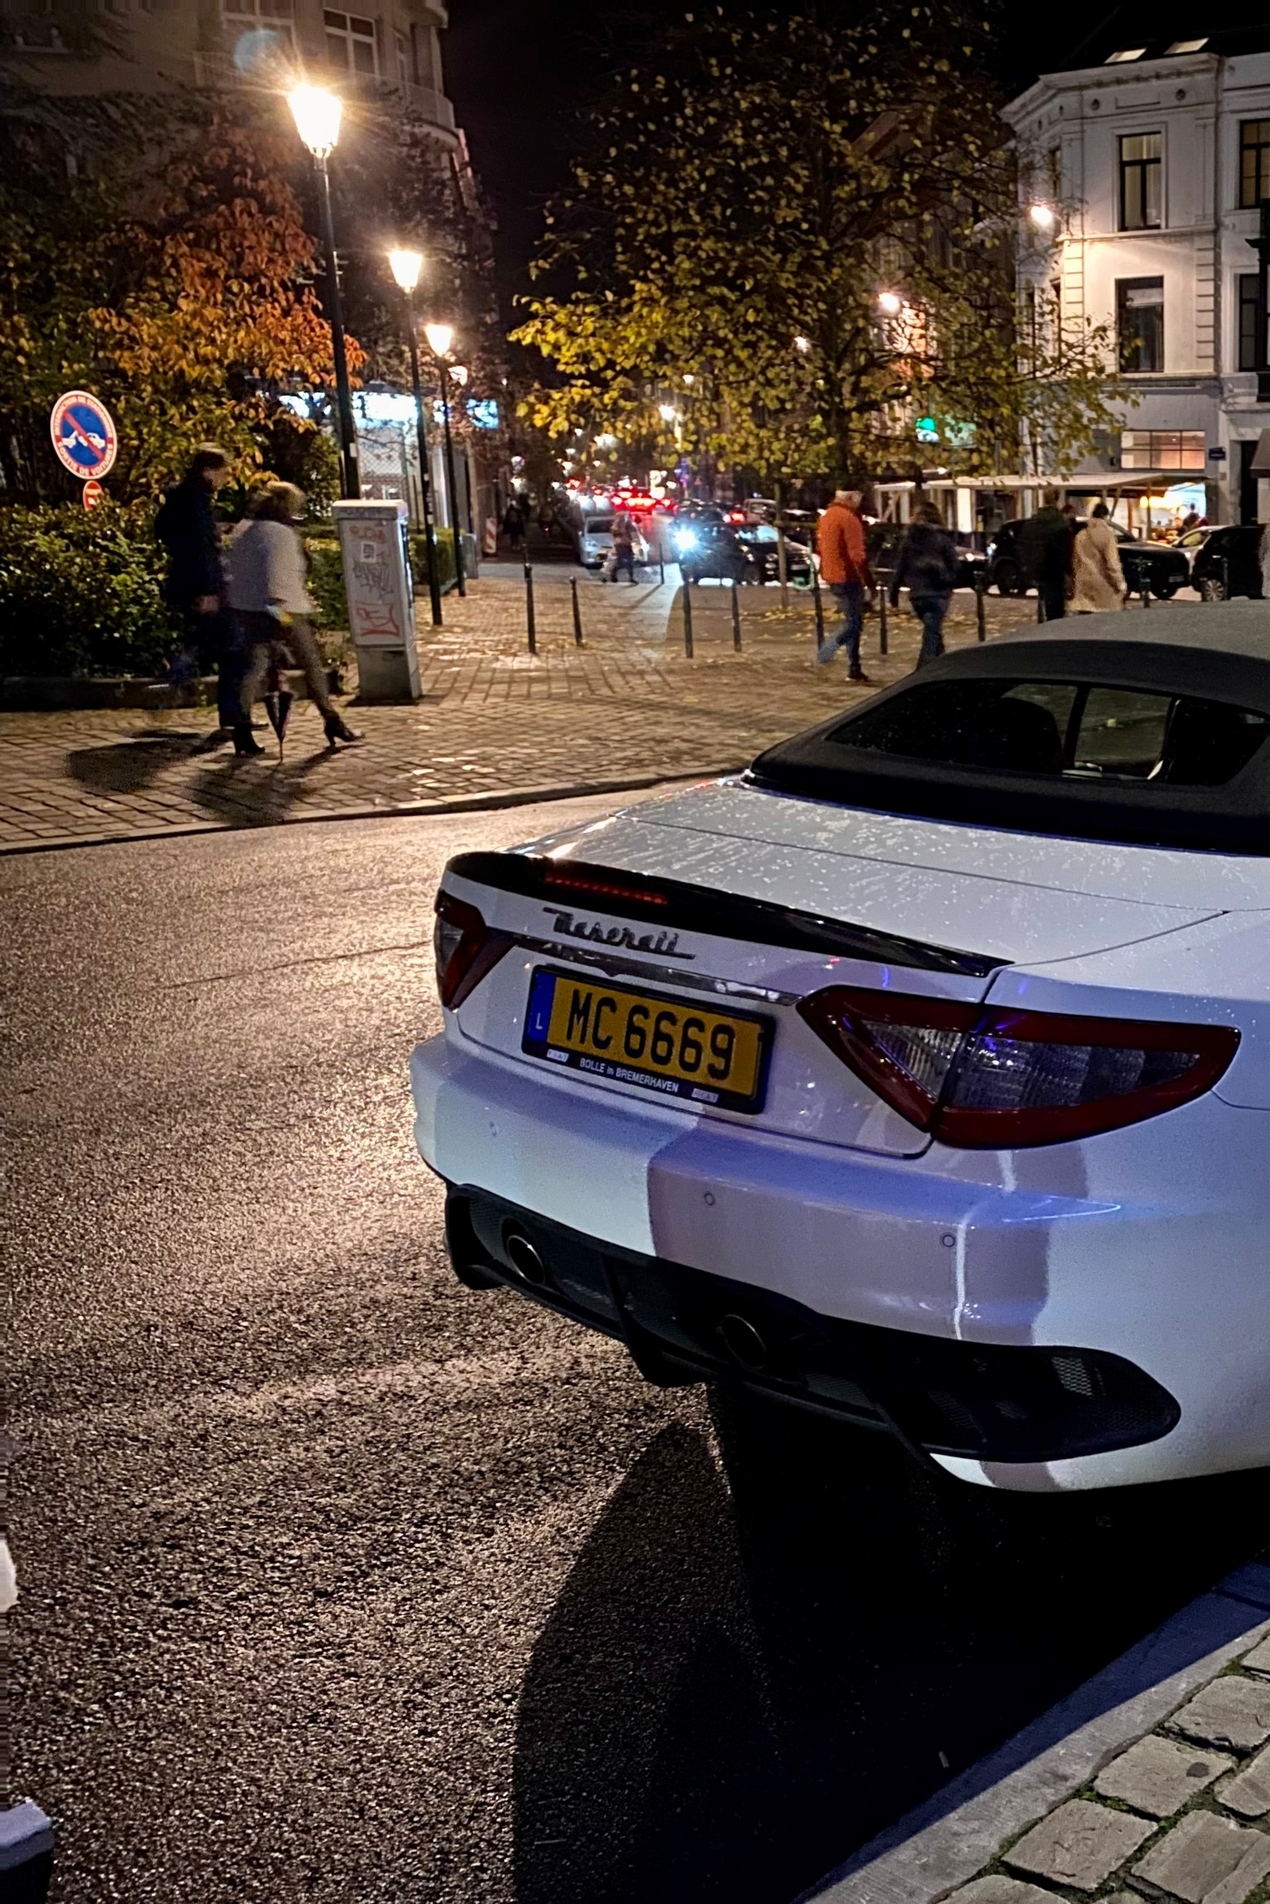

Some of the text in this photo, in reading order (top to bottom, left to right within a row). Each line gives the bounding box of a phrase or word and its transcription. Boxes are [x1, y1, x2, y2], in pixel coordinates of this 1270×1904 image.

[535, 1013, 543, 1030] L
[566, 989, 736, 1081] MC 6669
[579, 1057, 680, 1093] BOLLE in BREMERHAVEN
